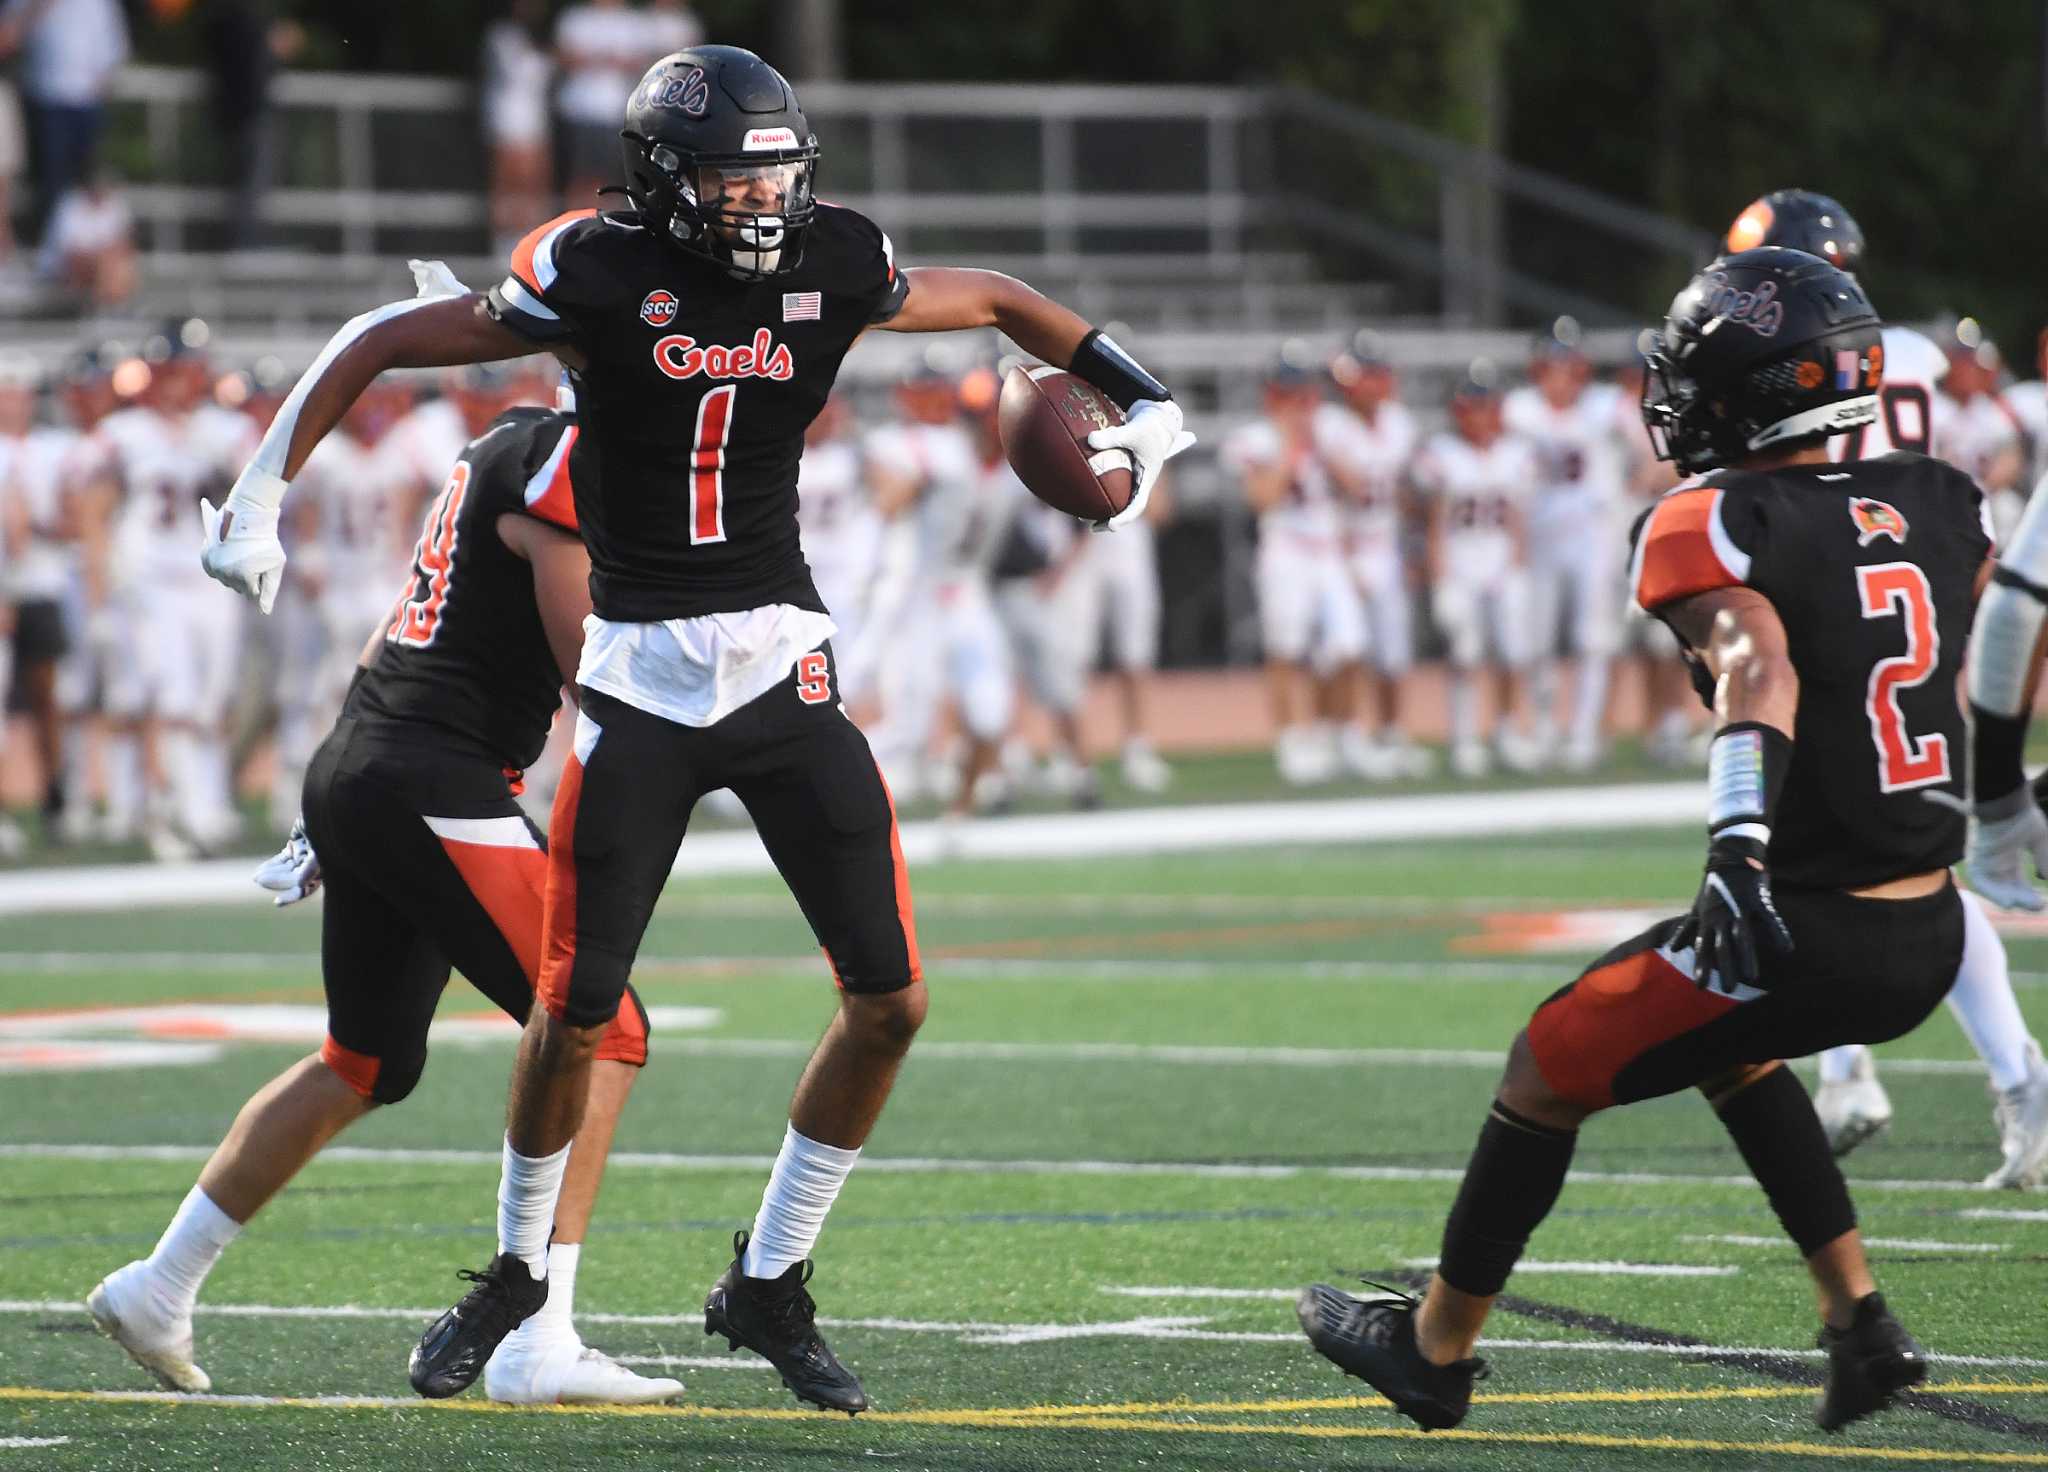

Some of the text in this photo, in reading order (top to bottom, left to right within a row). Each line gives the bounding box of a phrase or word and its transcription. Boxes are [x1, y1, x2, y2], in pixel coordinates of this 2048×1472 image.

[643, 301, 676, 316] SCC
[653, 327, 794, 381] Gaels
[689, 384, 737, 546] 1
[386, 459, 472, 649] 9
[796, 650, 831, 704] S
[1855, 561, 1952, 794] 2
